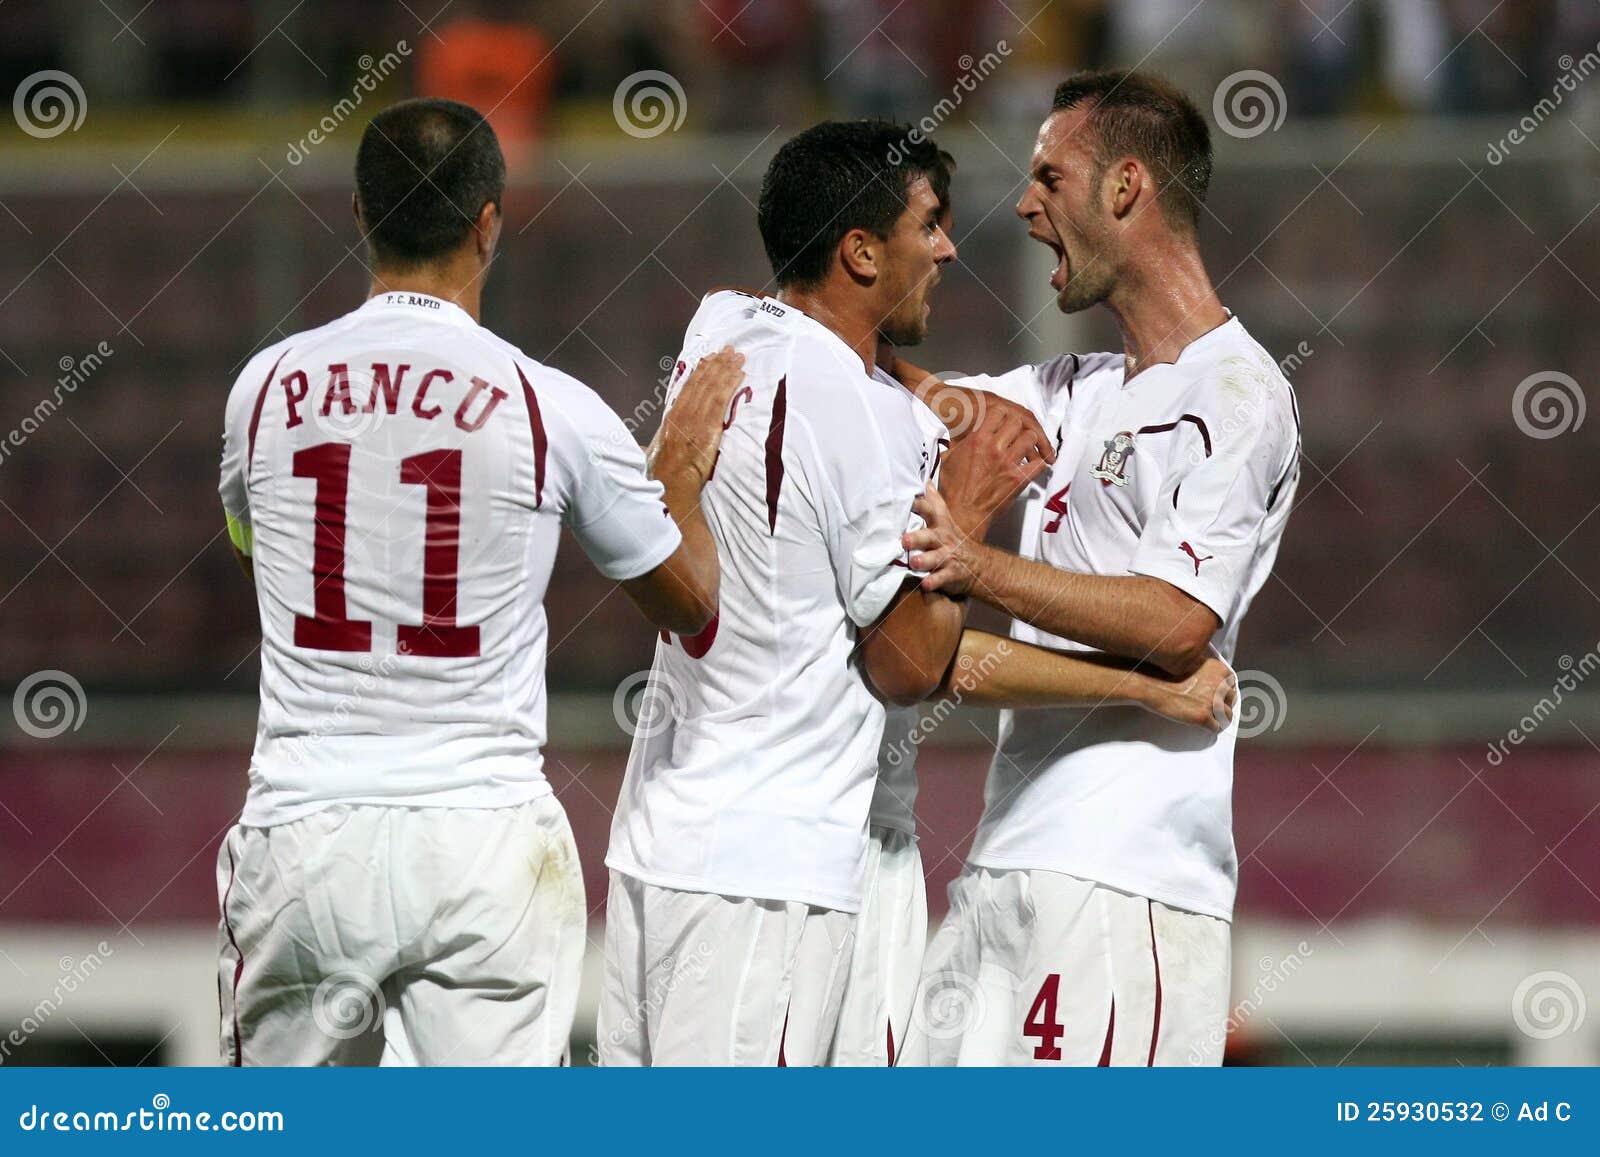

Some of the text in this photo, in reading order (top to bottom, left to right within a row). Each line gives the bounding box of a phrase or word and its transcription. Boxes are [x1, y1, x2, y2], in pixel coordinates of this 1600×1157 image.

[280, 363, 509, 433] PANCU
[292, 442, 481, 658] 11
[1023, 973, 1065, 1060] 4
